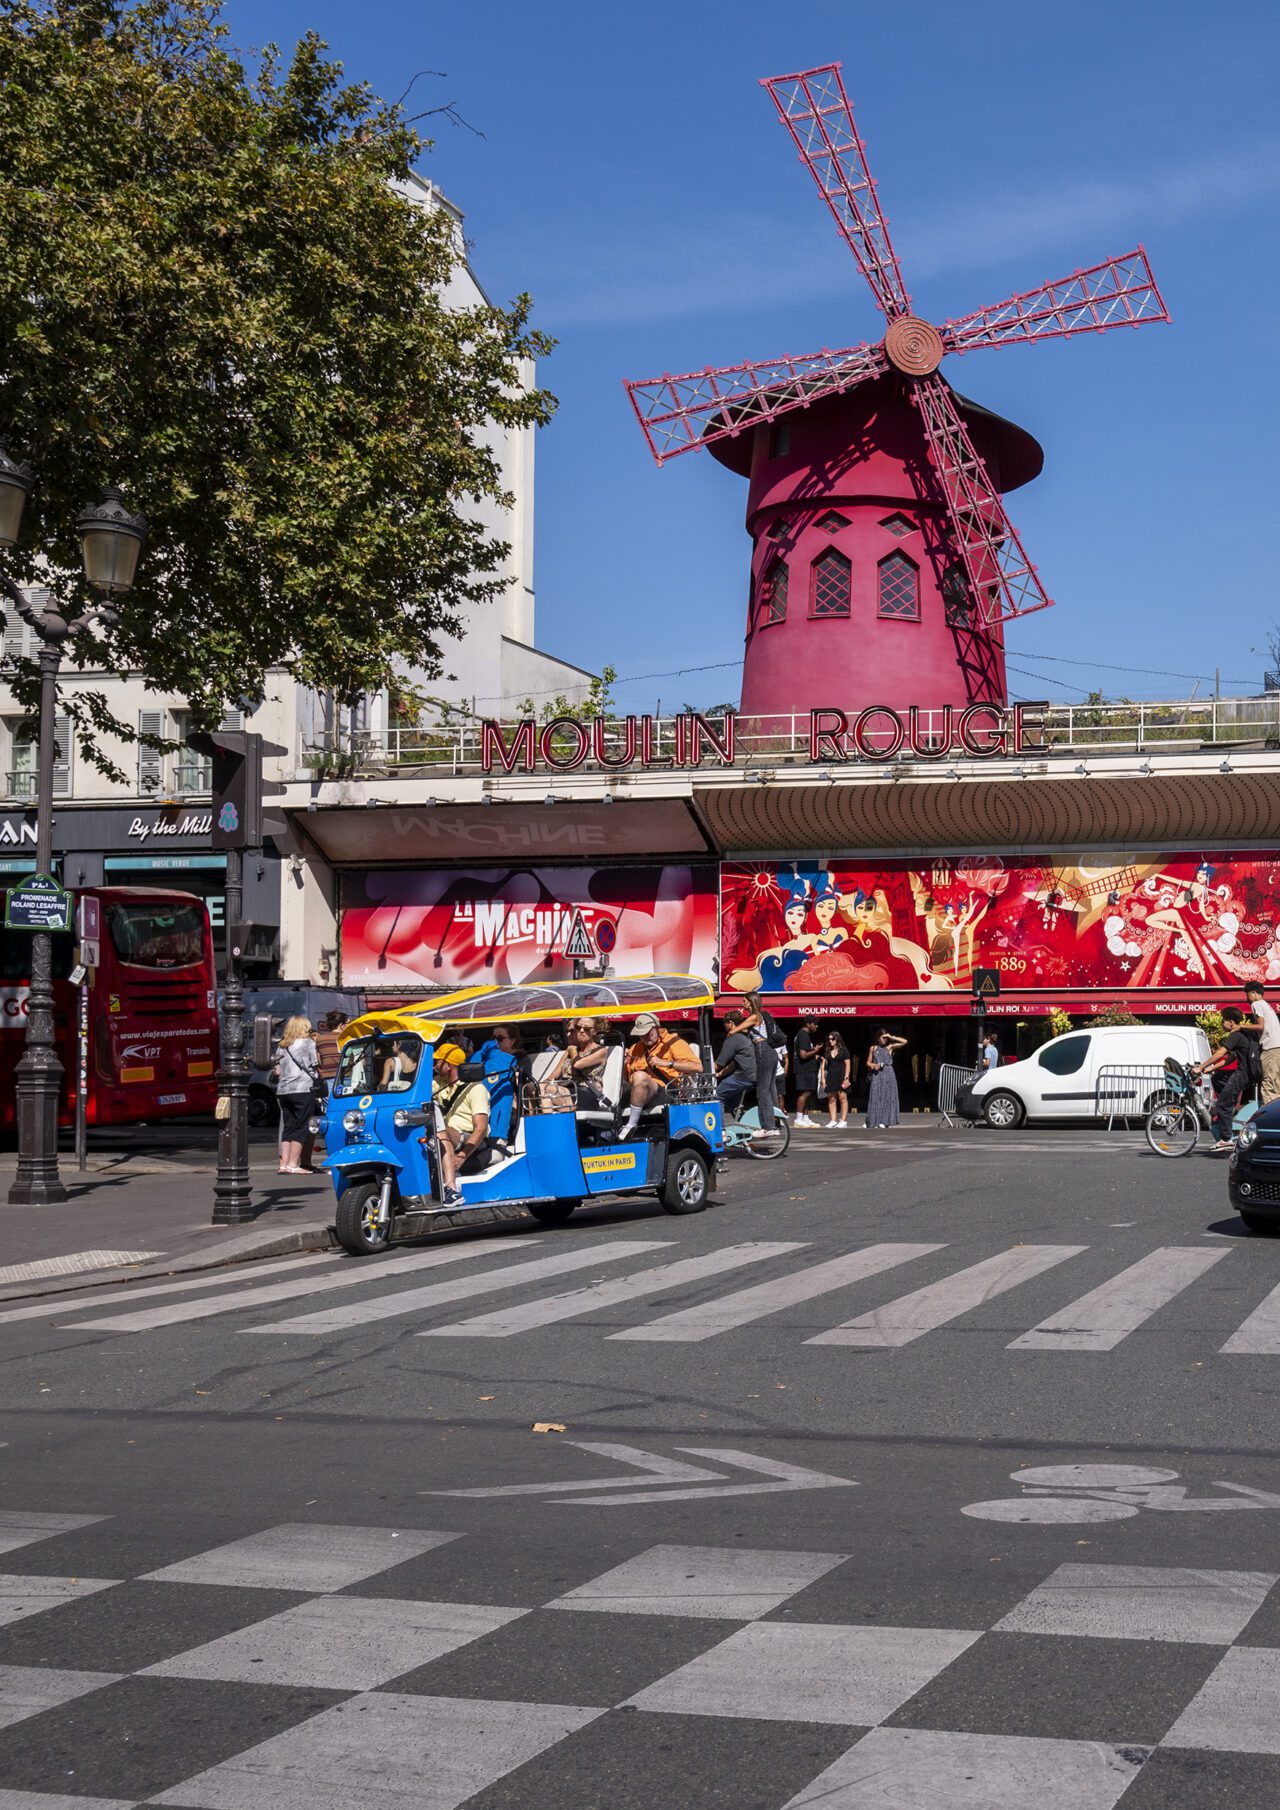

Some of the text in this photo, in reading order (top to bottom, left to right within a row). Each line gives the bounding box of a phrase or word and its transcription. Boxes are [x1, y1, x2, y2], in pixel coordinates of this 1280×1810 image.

[482, 701, 1051, 773] MOULIN ROUGE
[128, 815, 213, 842] By the Mill
[152, 859, 189, 868] MUSIC VENUE
[21, 894, 58, 902] PROMENADE
[36, 902, 66, 910] LESAFFRE
[454, 900, 474, 917] LA
[995, 957, 1027, 974] 1889
[798, 1006, 857, 1015] MOULIN ROUGE
[1155, 1004, 1217, 1012] MOULIN ROUGE
[144, 1047, 161, 1057] VPT
[583, 1160, 607, 1169] TUKTUK
[616, 1157, 632, 1165] PARIS
